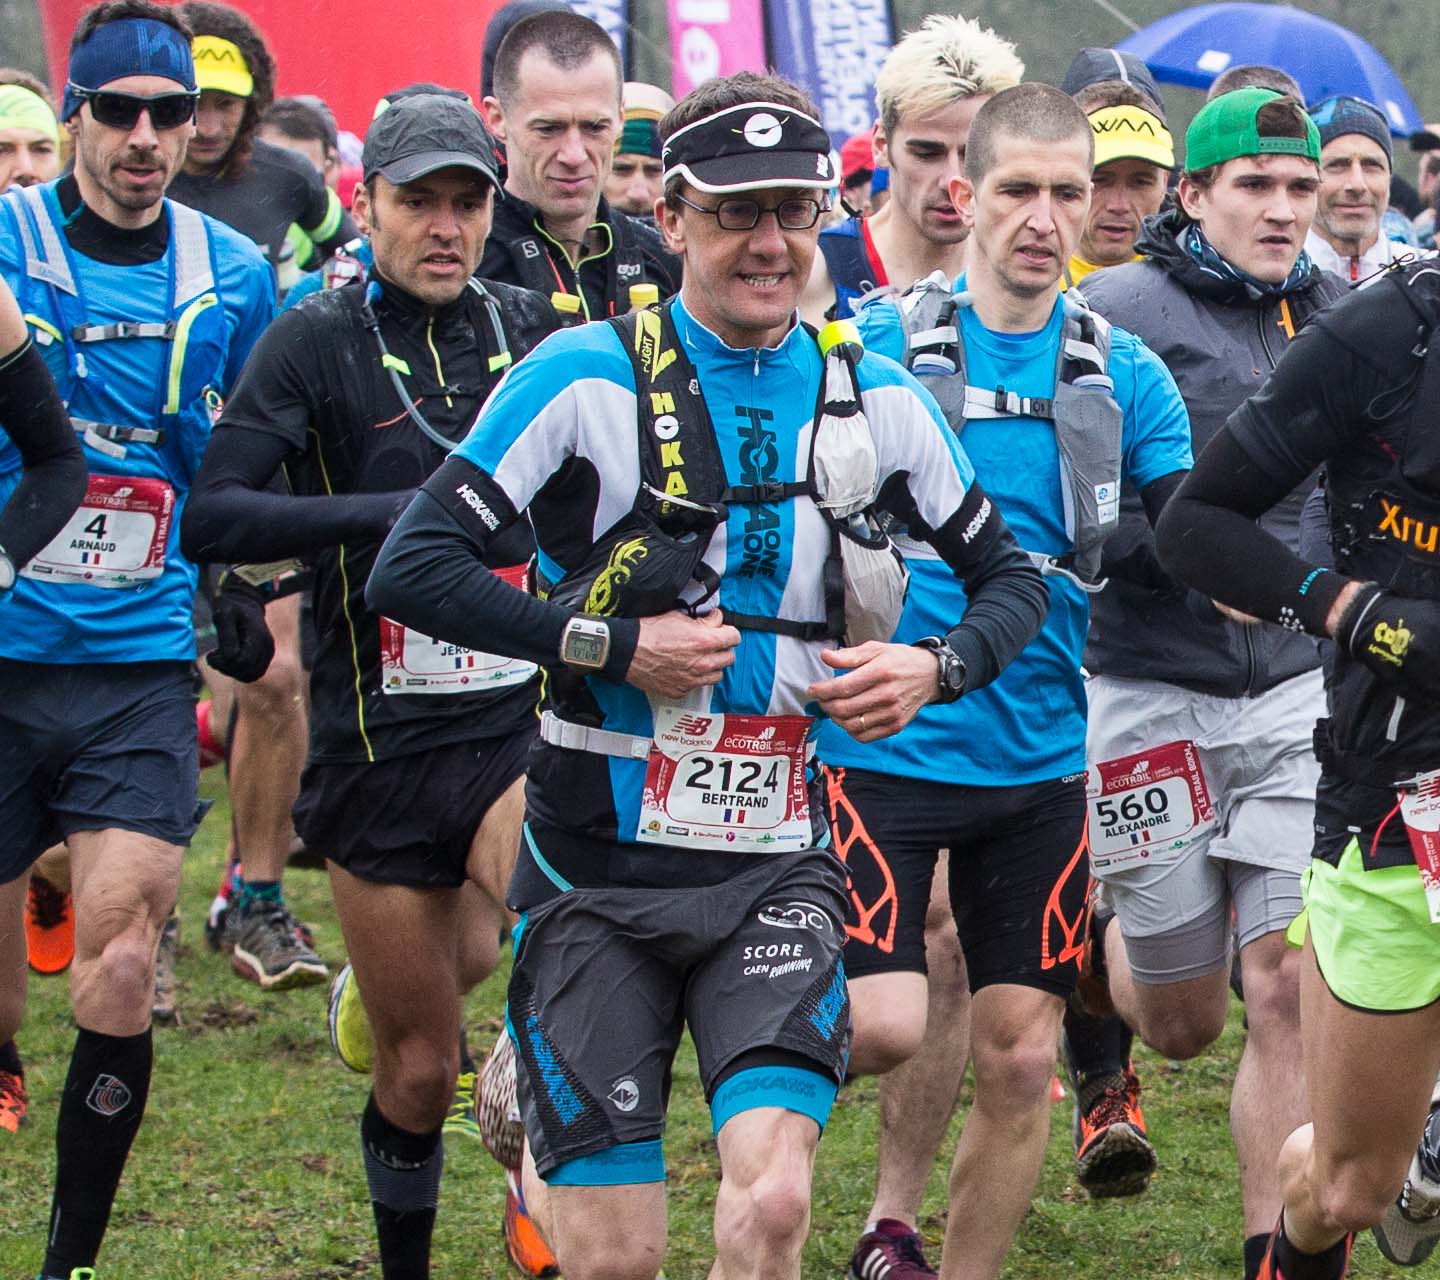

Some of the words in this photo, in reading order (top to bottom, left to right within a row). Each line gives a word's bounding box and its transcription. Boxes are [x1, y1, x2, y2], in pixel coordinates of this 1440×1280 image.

[84, 514, 108, 540] 4
[70, 539, 116, 553] ARNAUD
[661, 733, 679, 742] new
[679, 736, 712, 747] balance
[686, 756, 779, 793] 2124
[702, 793, 769, 808] BERTRAND
[1096, 788, 1169, 827] 560
[1410, 804, 1428, 816] new
[1105, 813, 1171, 838] ALEXANDRE
[743, 943, 805, 960] SCORE
[743, 963, 769, 976] CAEN
[769, 958, 813, 979] RUNNING
